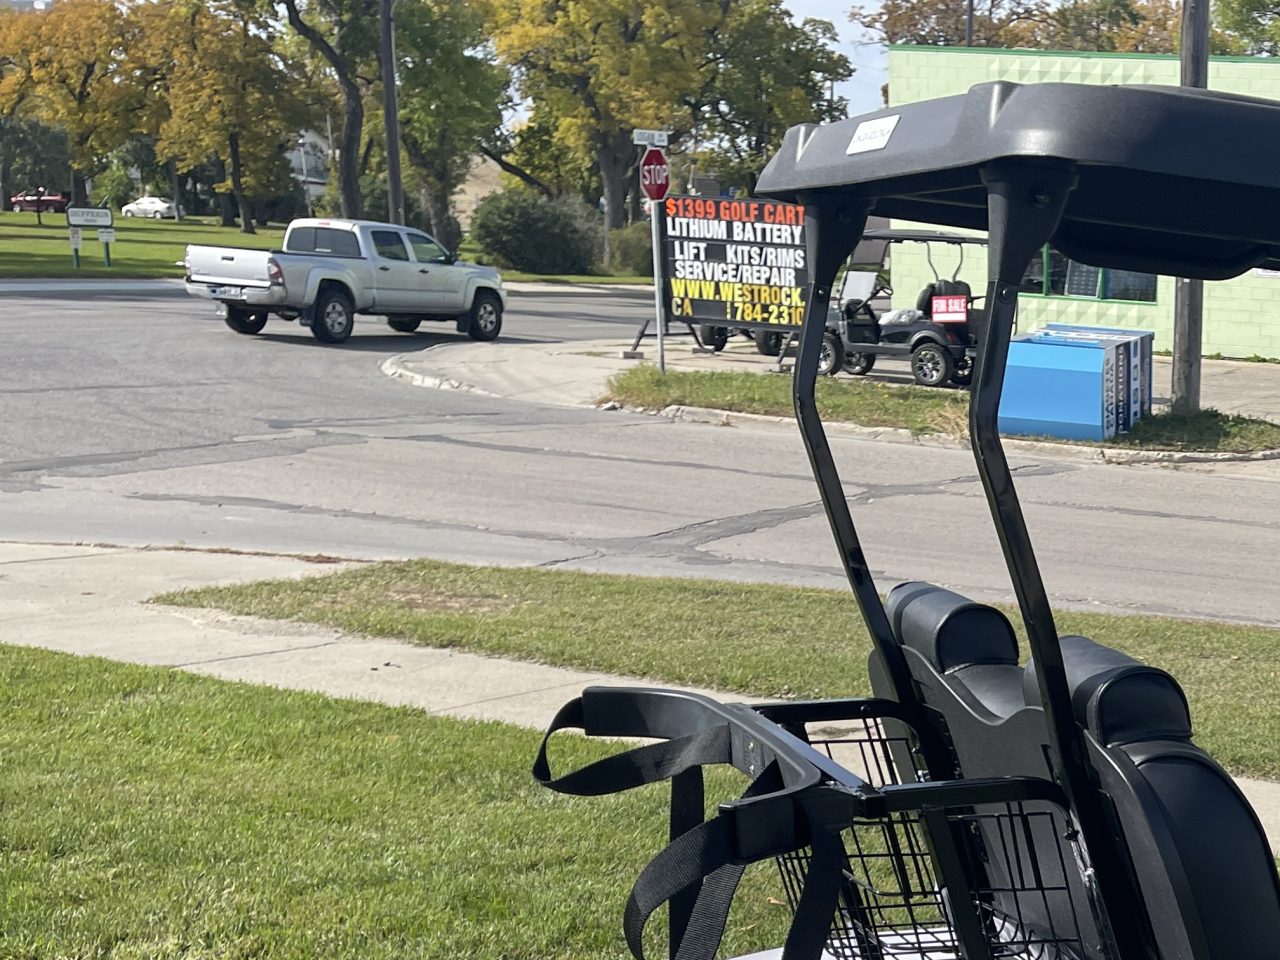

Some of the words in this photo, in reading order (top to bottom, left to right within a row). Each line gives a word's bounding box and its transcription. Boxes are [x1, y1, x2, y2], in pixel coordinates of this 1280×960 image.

[642, 164, 668, 185] STOP
[666, 197, 715, 219] $1399
[720, 200, 759, 222] GOLF
[763, 204, 805, 225] CART
[666, 216, 727, 240] LITHIUM
[733, 221, 802, 245] BATTERY
[674, 240, 707, 261] LIFT
[726, 244, 805, 269] KITS/RIMS
[675, 260, 796, 287] SERVICE/REPAIR
[671, 278, 806, 307] WWW.WESTROCK.
[932, 299, 948, 313] FOR
[948, 298, 967, 312] SALE
[671, 297, 693, 317] CA
[734, 302, 804, 325] 784-2310
